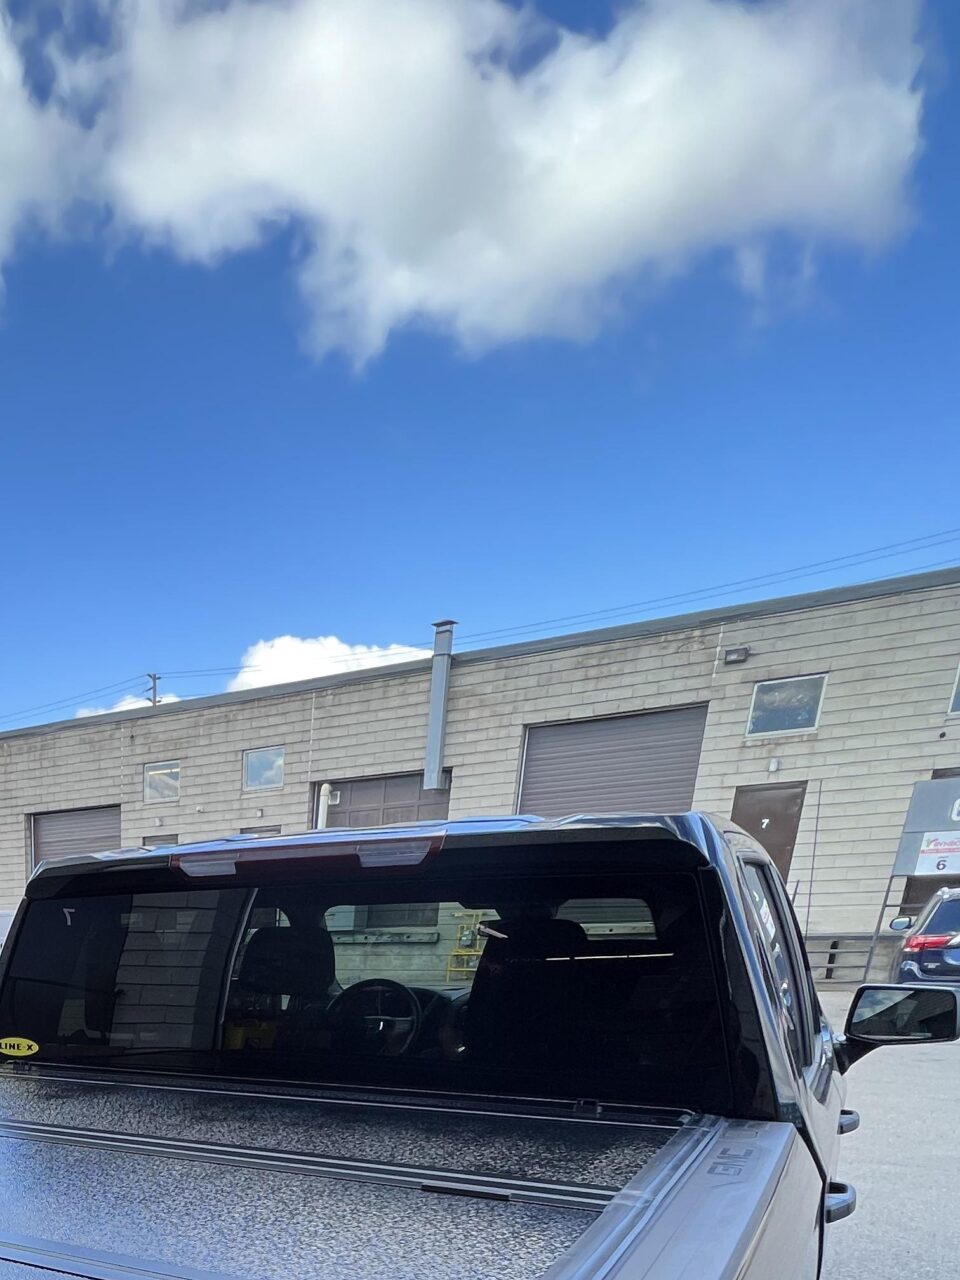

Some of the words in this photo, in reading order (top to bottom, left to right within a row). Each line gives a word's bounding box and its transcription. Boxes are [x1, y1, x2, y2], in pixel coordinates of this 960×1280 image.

[761, 818, 770, 829] 7
[936, 859, 947, 870] 6
[706, 1147, 756, 1176] GMC
